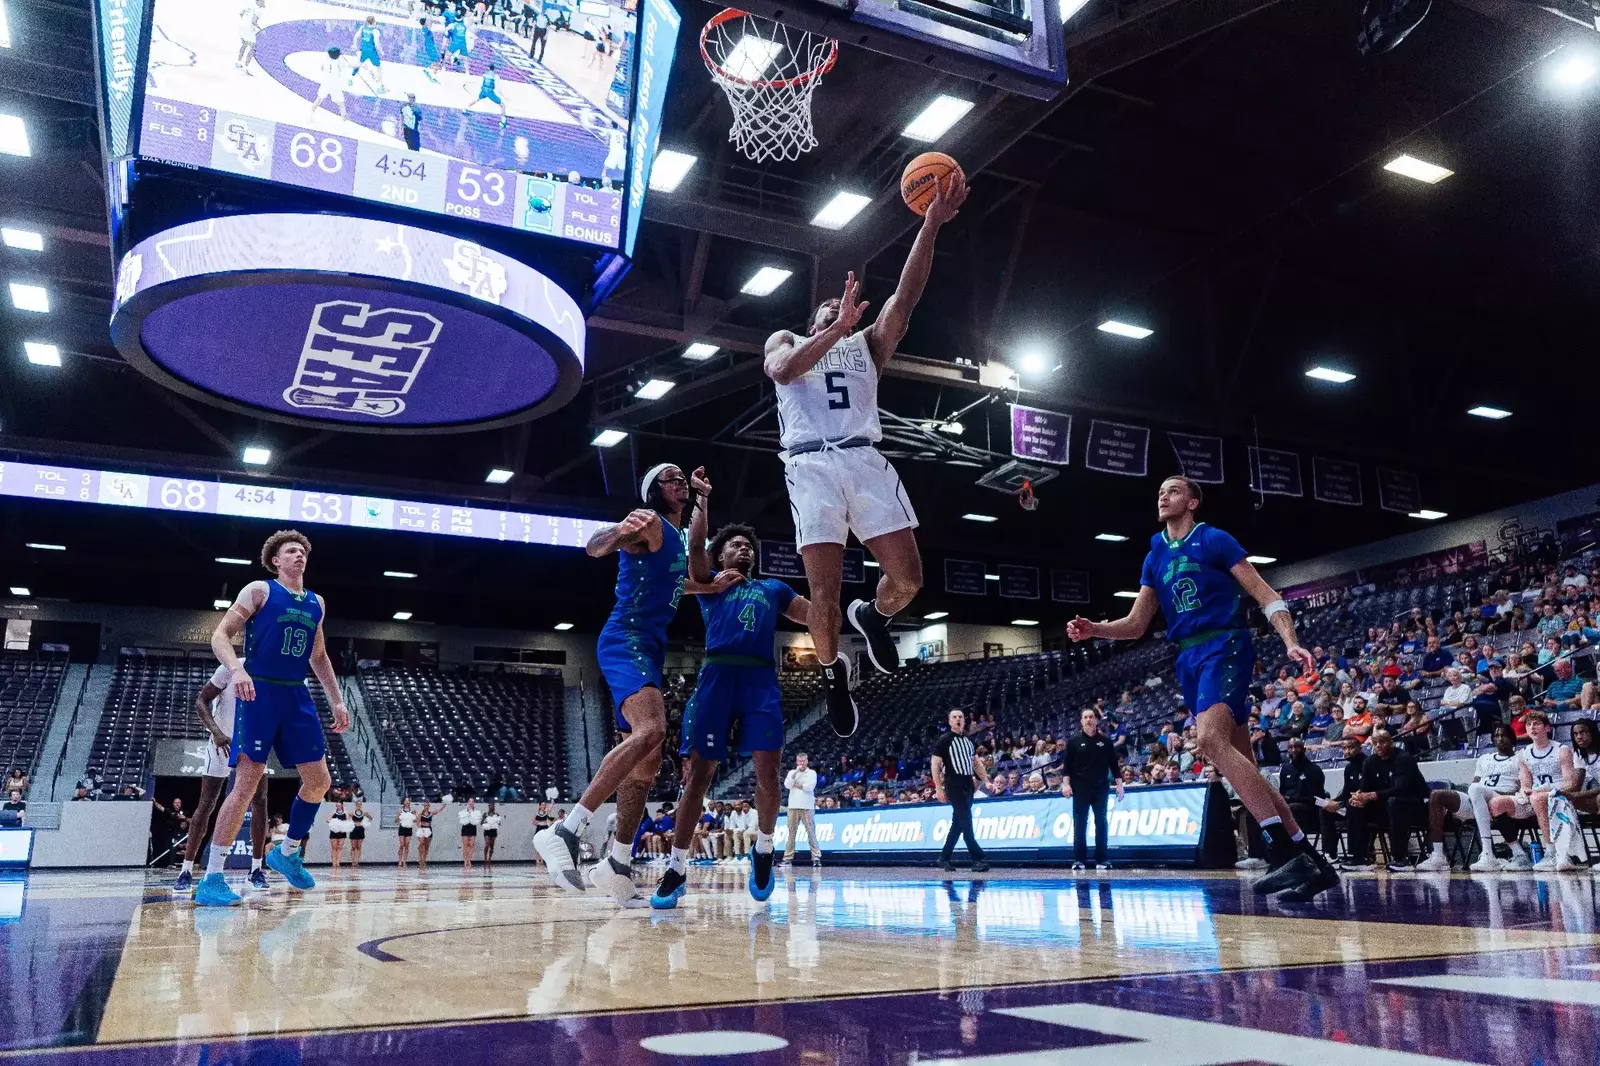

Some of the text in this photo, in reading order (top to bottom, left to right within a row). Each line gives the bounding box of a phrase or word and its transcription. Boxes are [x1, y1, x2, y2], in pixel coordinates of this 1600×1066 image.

[152, 101, 210, 123] TOL 3
[148, 122, 208, 142] FLS 8
[227, 123, 261, 162] SFA
[141, 155, 199, 171] DAKTRONICS
[290, 132, 343, 174] 68
[375, 153, 427, 182] 4:54
[380, 184, 419, 204] 2ND
[457, 166, 506, 207] 53
[445, 202, 481, 219] POSS
[573, 192, 620, 210] TOL 2
[571, 211, 619, 228] FLS 6
[565, 224, 613, 244] BONUS
[299, 300, 443, 394] SFA
[824, 371, 851, 410] 5
[37, 470, 91, 485] TOL 3
[34, 483, 89, 500] FLS 8
[161, 480, 206, 510] 68
[235, 488, 275, 504] 4:54
[301, 493, 342, 523] 53
[401, 504, 440, 519] TOL 2
[399, 518, 440, 531] FLS 6
[1171, 577, 1202, 614] 12
[738, 603, 756, 632] 4
[281, 626, 308, 657] 13
[933, 807, 1040, 844] oimum.
